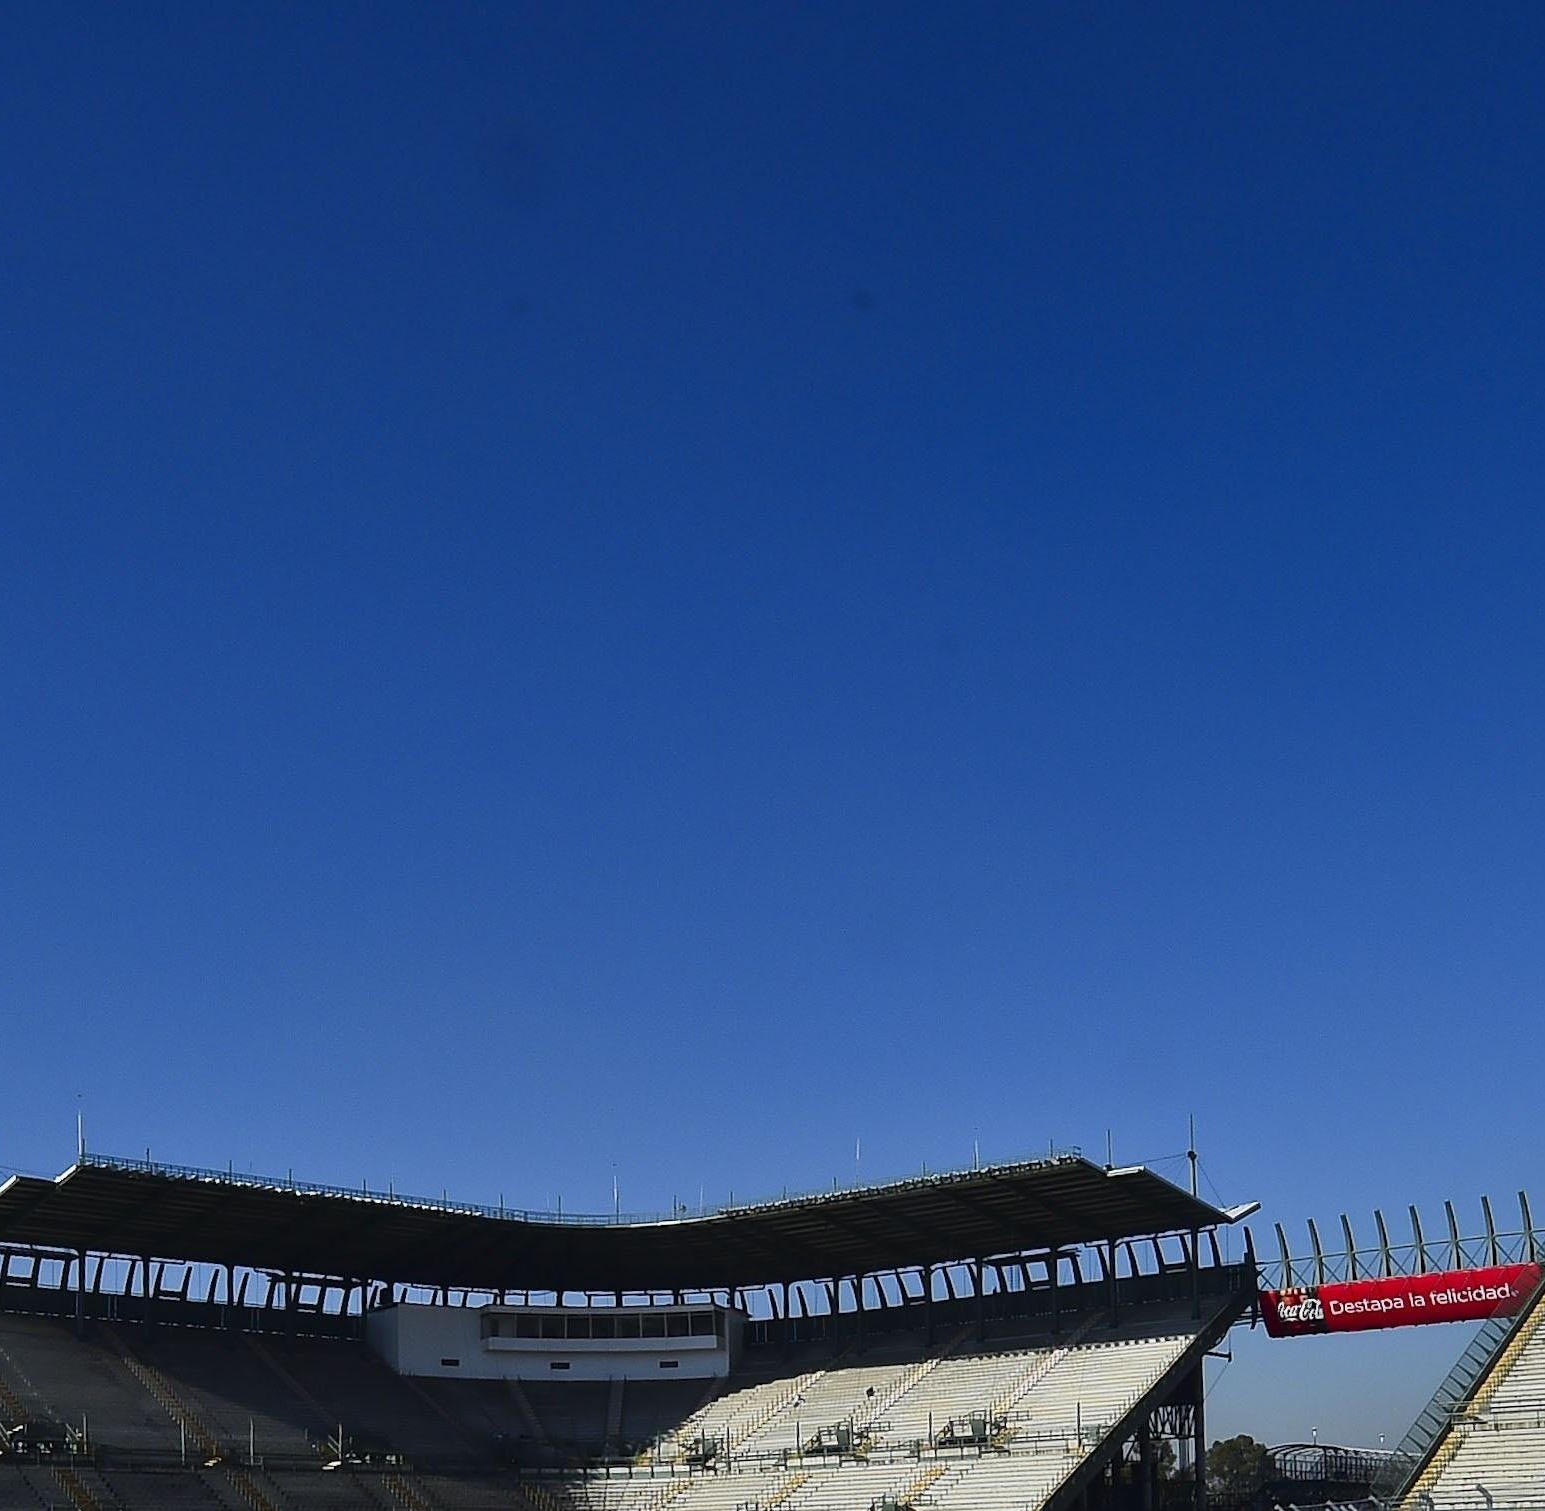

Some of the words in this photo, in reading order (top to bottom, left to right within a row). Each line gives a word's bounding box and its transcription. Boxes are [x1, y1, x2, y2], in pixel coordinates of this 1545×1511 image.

[1329, 1298, 1404, 1316] Destapa
[1408, 1292, 1426, 1308] la
[1429, 1282, 1519, 1306] felicidad.
